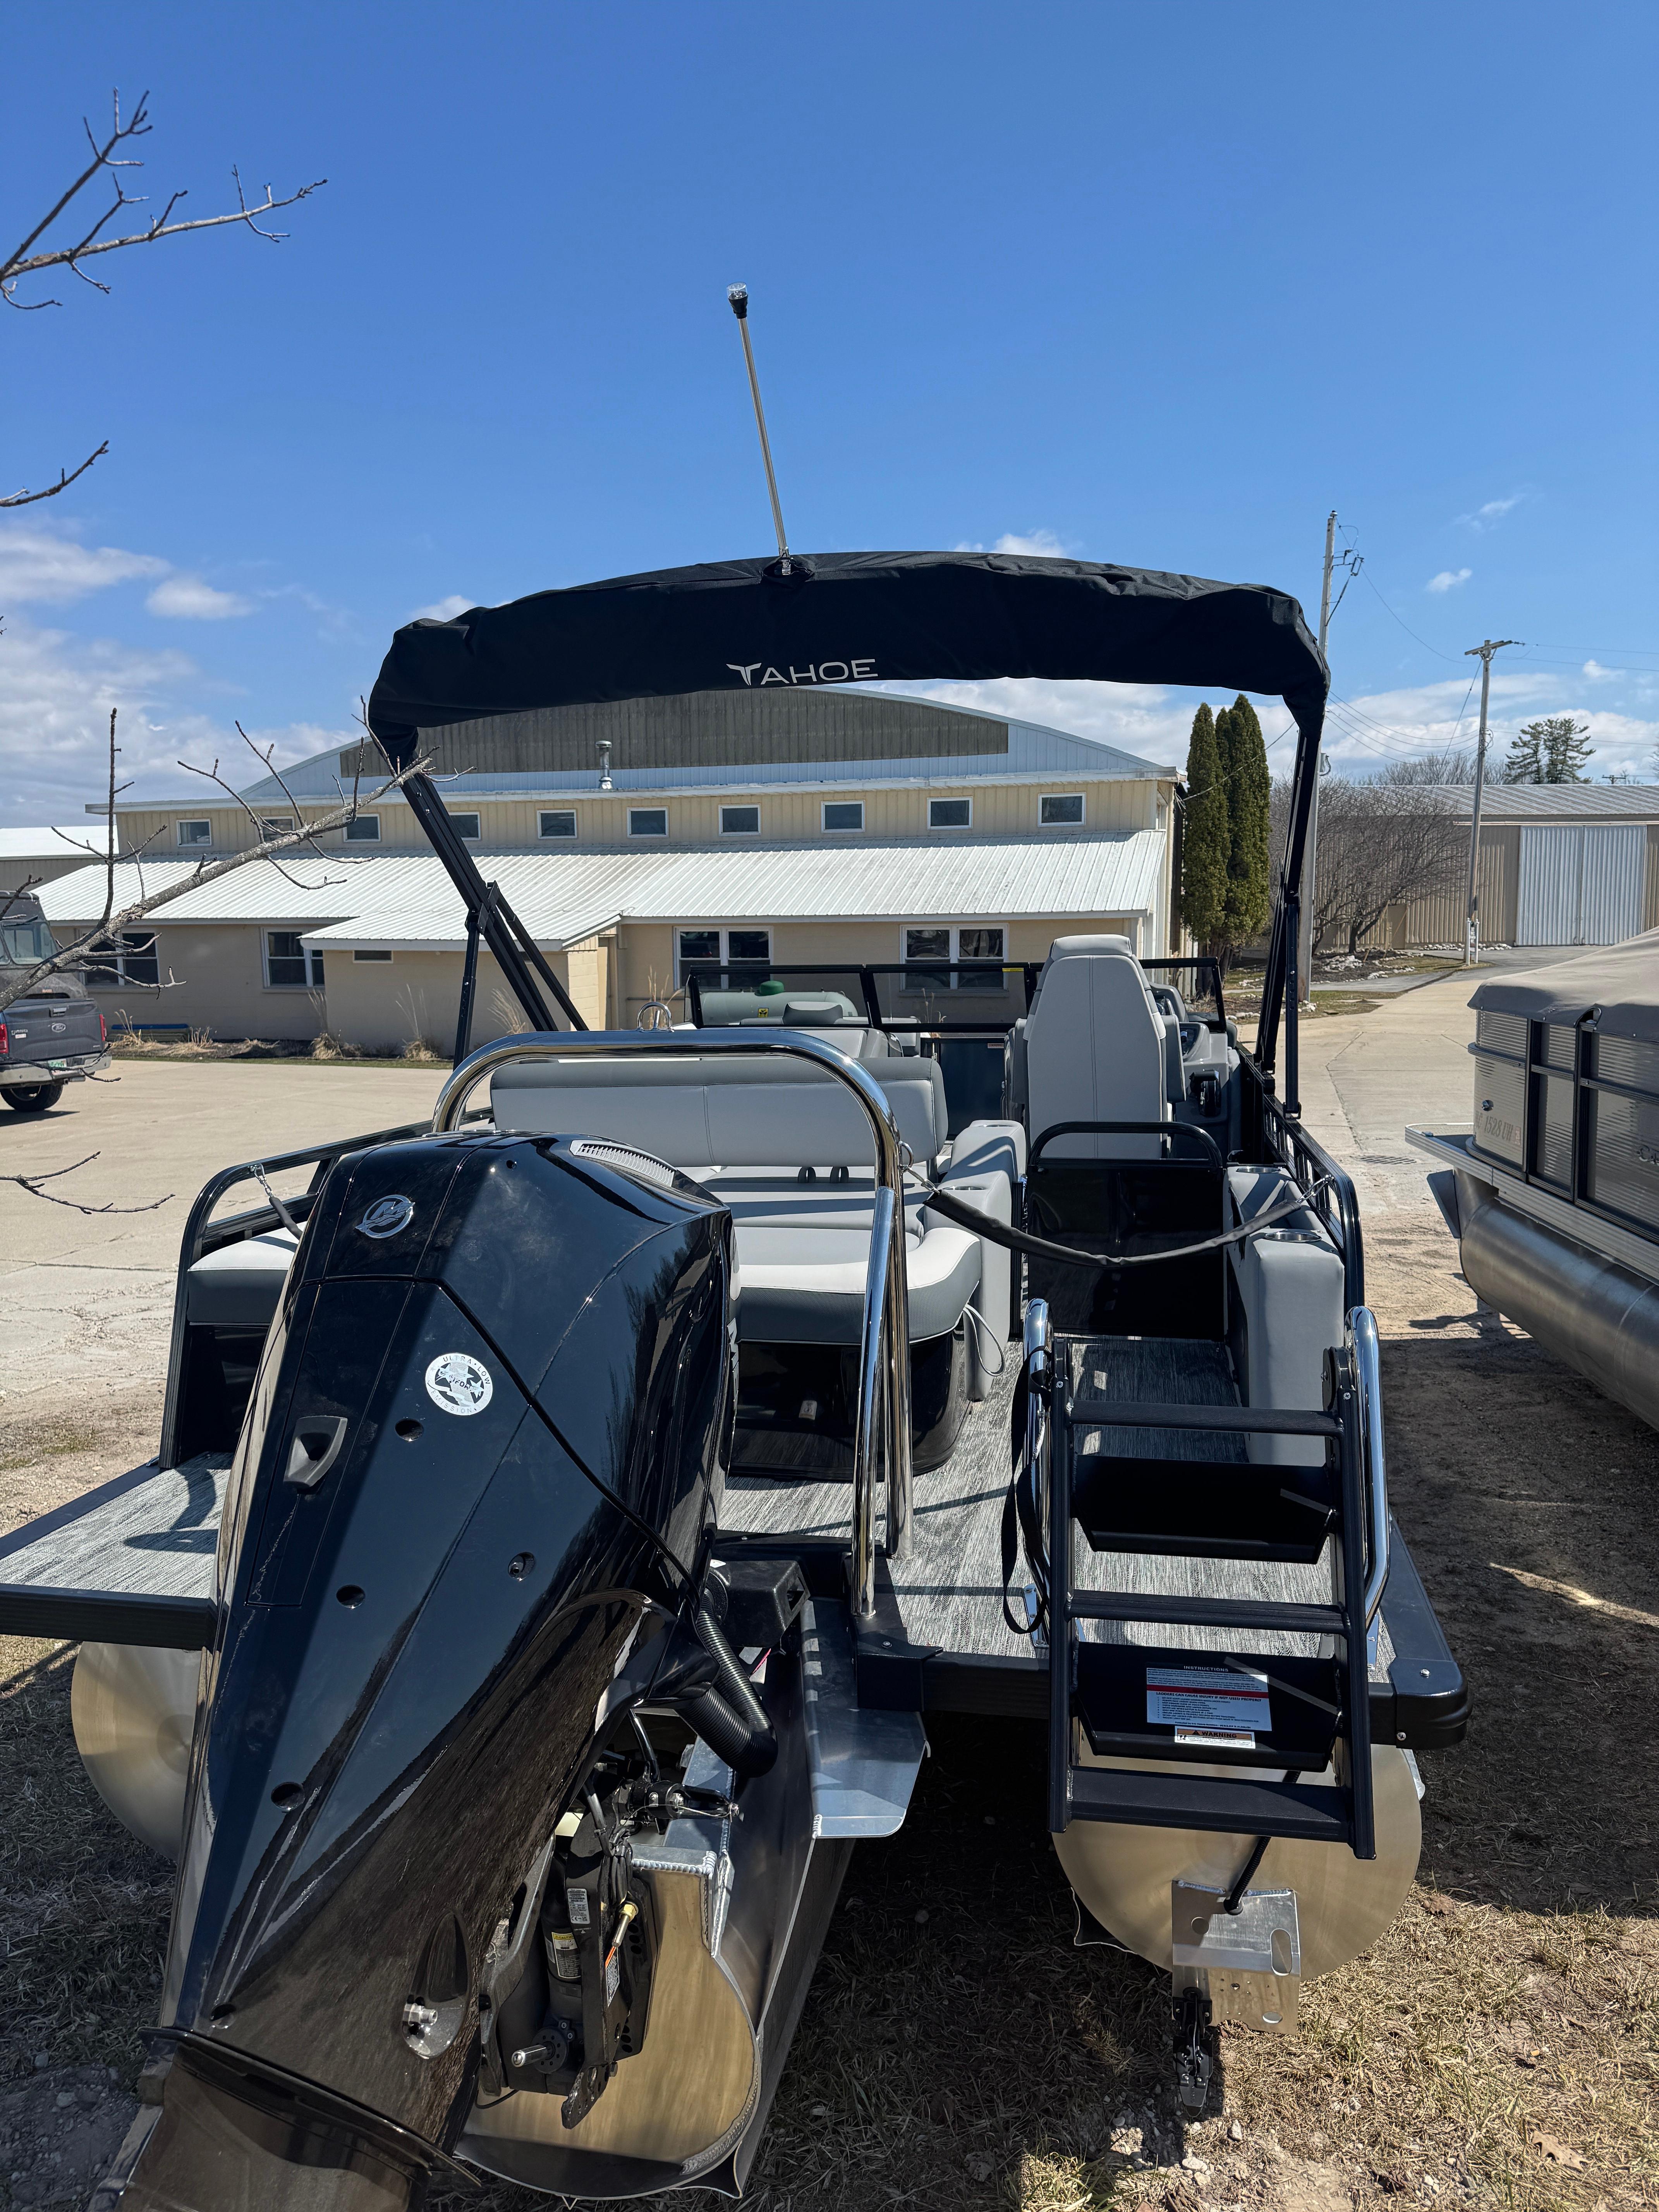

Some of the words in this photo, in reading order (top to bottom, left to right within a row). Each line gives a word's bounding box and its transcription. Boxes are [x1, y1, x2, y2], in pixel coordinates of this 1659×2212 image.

[726, 659, 878, 685] TAHOE
[1484, 1115, 1502, 1137] 1528
[443, 1355, 471, 1364] ULTRA
[477, 1366, 491, 1384] LOW
[431, 1390, 472, 1413] EMISSION
